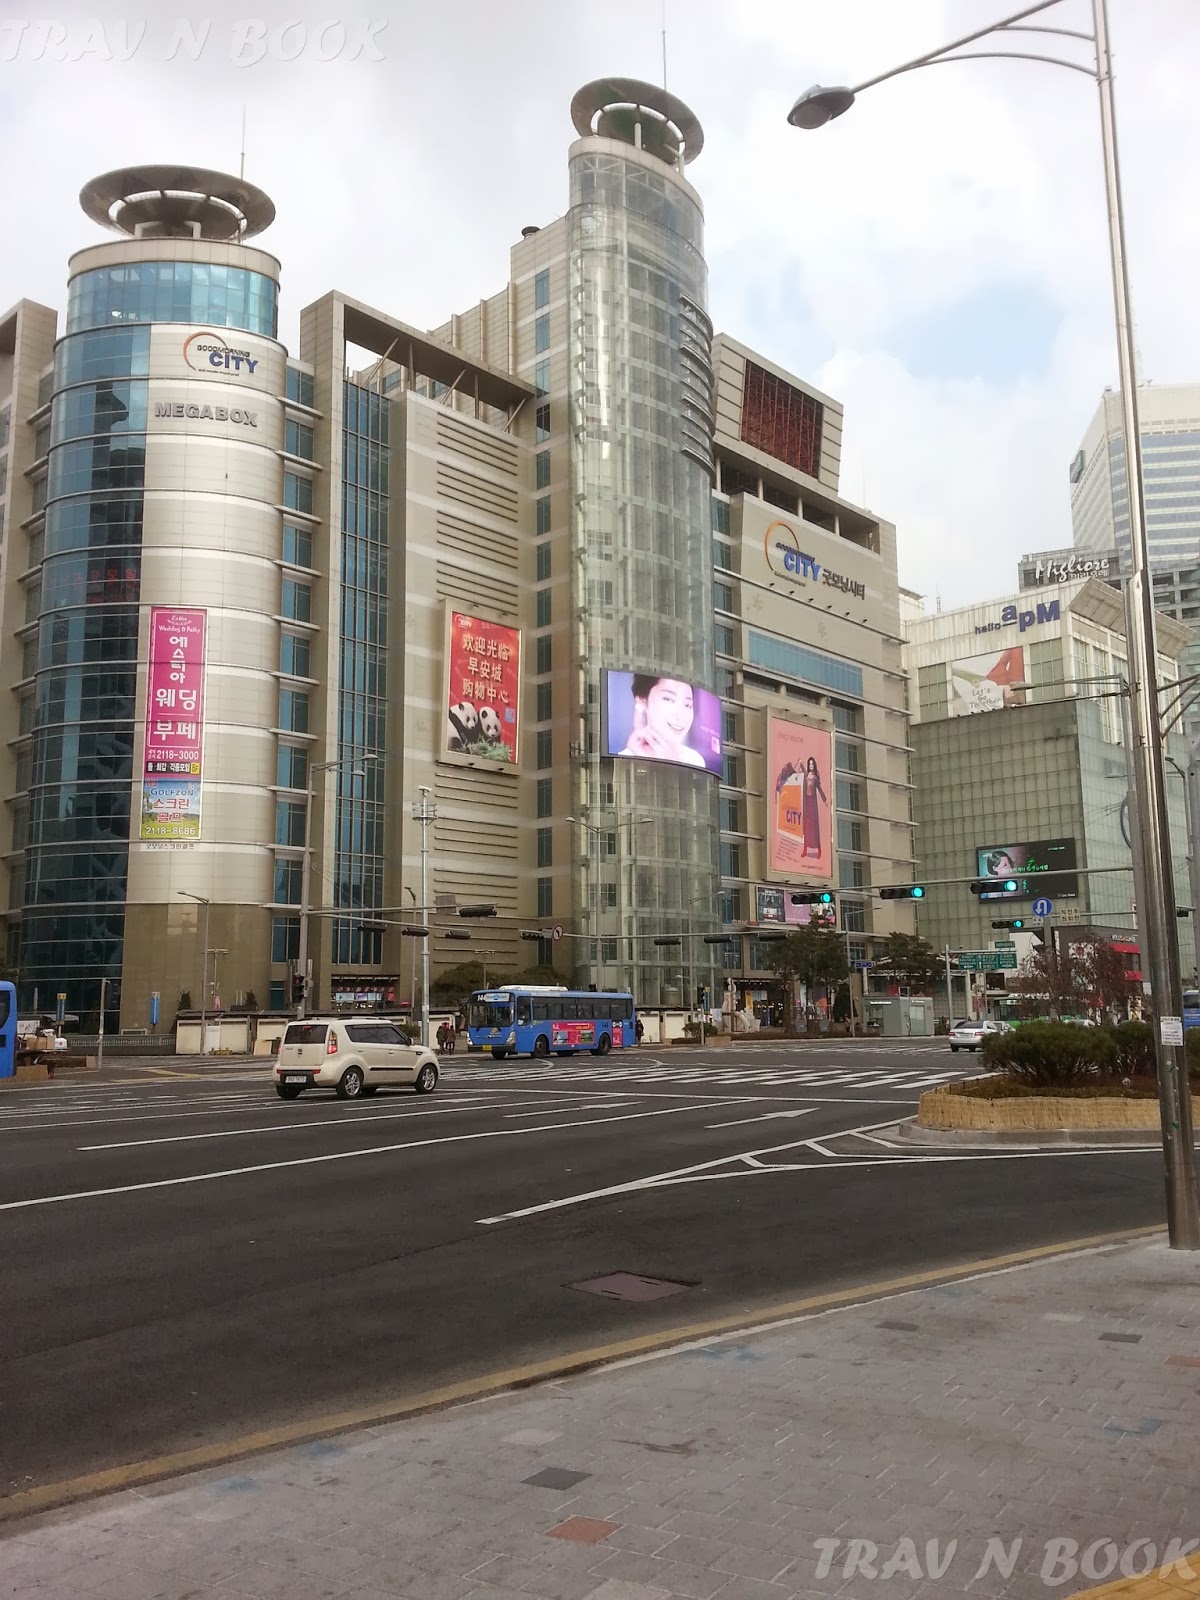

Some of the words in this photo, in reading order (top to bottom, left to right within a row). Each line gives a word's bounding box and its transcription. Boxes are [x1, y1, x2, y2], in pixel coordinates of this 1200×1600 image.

[197, 345, 251, 358] GOODMORNING
[209, 352, 259, 374] CITY
[154, 402, 258, 428] MEGABOX
[784, 552, 822, 582] CITY
[1035, 555, 1110, 582] Migliore
[822, 568, 866, 600] 굿모닝시티
[159, 624, 181, 633] Wedding
[975, 622, 1001, 635] hello
[463, 633, 510, 661] 欢迎光临
[468, 656, 502, 682] 早安城
[155, 688, 197, 711] 웨딩
[462, 678, 509, 704] 购物中心
[153, 720, 196, 741] 부페
[157, 750, 199, 760] 2118-3000
[150, 787, 194, 796] GOLFZON
[153, 798, 190, 810] 스크린
[785, 809, 802, 826] CITY
